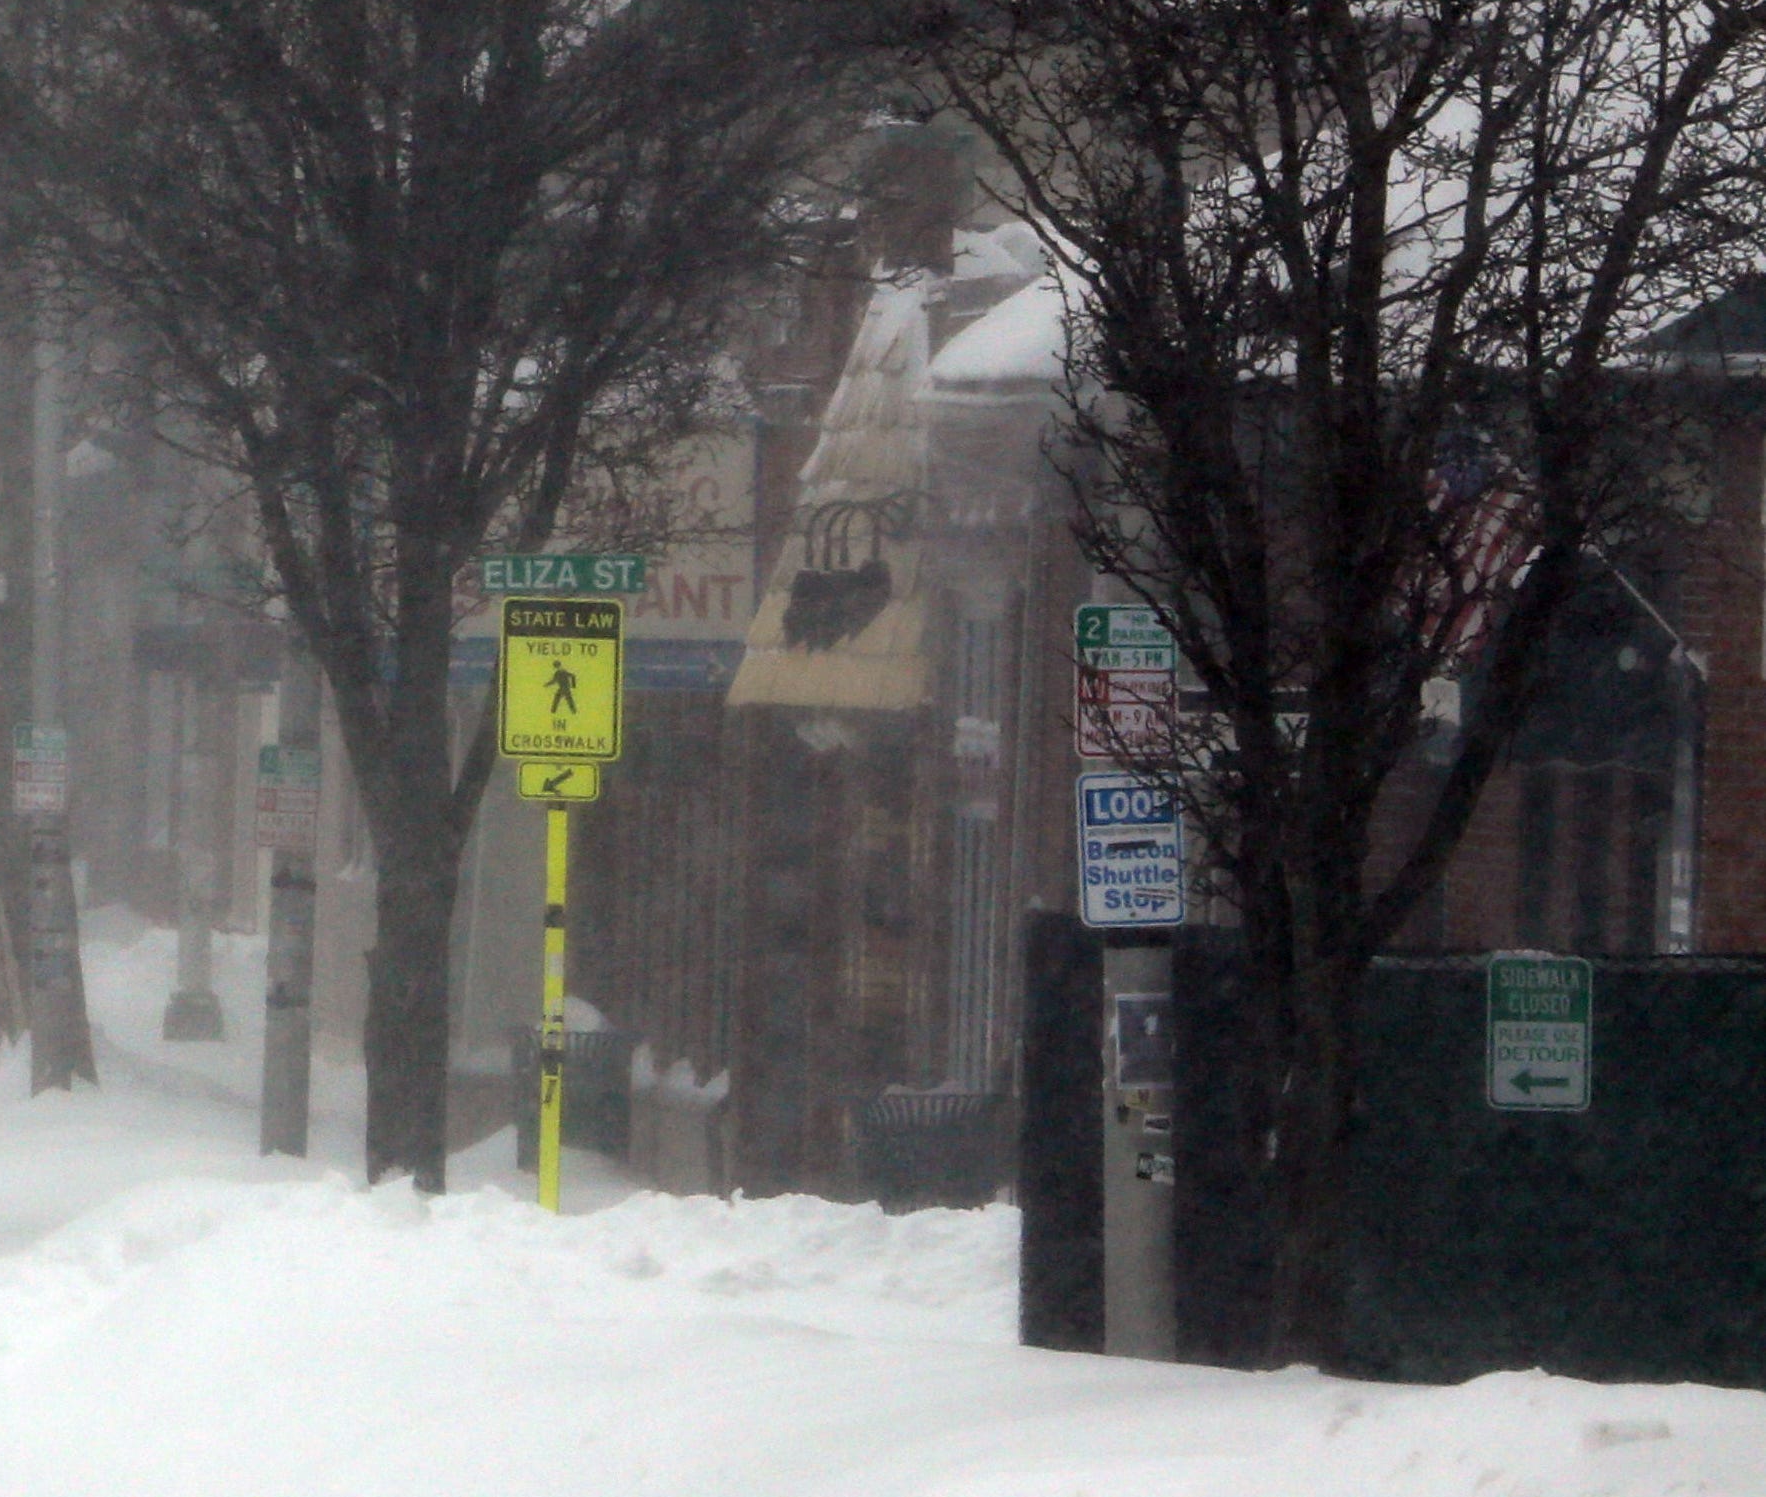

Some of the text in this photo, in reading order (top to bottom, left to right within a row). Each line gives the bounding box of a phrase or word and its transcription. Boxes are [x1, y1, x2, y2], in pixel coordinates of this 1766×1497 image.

[483, 560, 644, 590] ELIZA ST.
[627, 573, 746, 621] ANT
[510, 611, 615, 629] STATE LAW
[1085, 616, 1101, 640] 2
[525, 641, 599, 657] YIELD TO
[552, 718, 566, 732] IN
[511, 734, 606, 749] CROSSWALK
[1093, 790, 1170, 820] LOOP
[1086, 865, 1176, 886] Shuttle
[1104, 888, 1166, 913] Stop
[1499, 966, 1580, 989] SIDEWALK
[1508, 991, 1571, 1015] CLOSED
[1498, 1027, 1580, 1043] PLEASE USE
[1497, 1046, 1581, 1062] DETOUR
